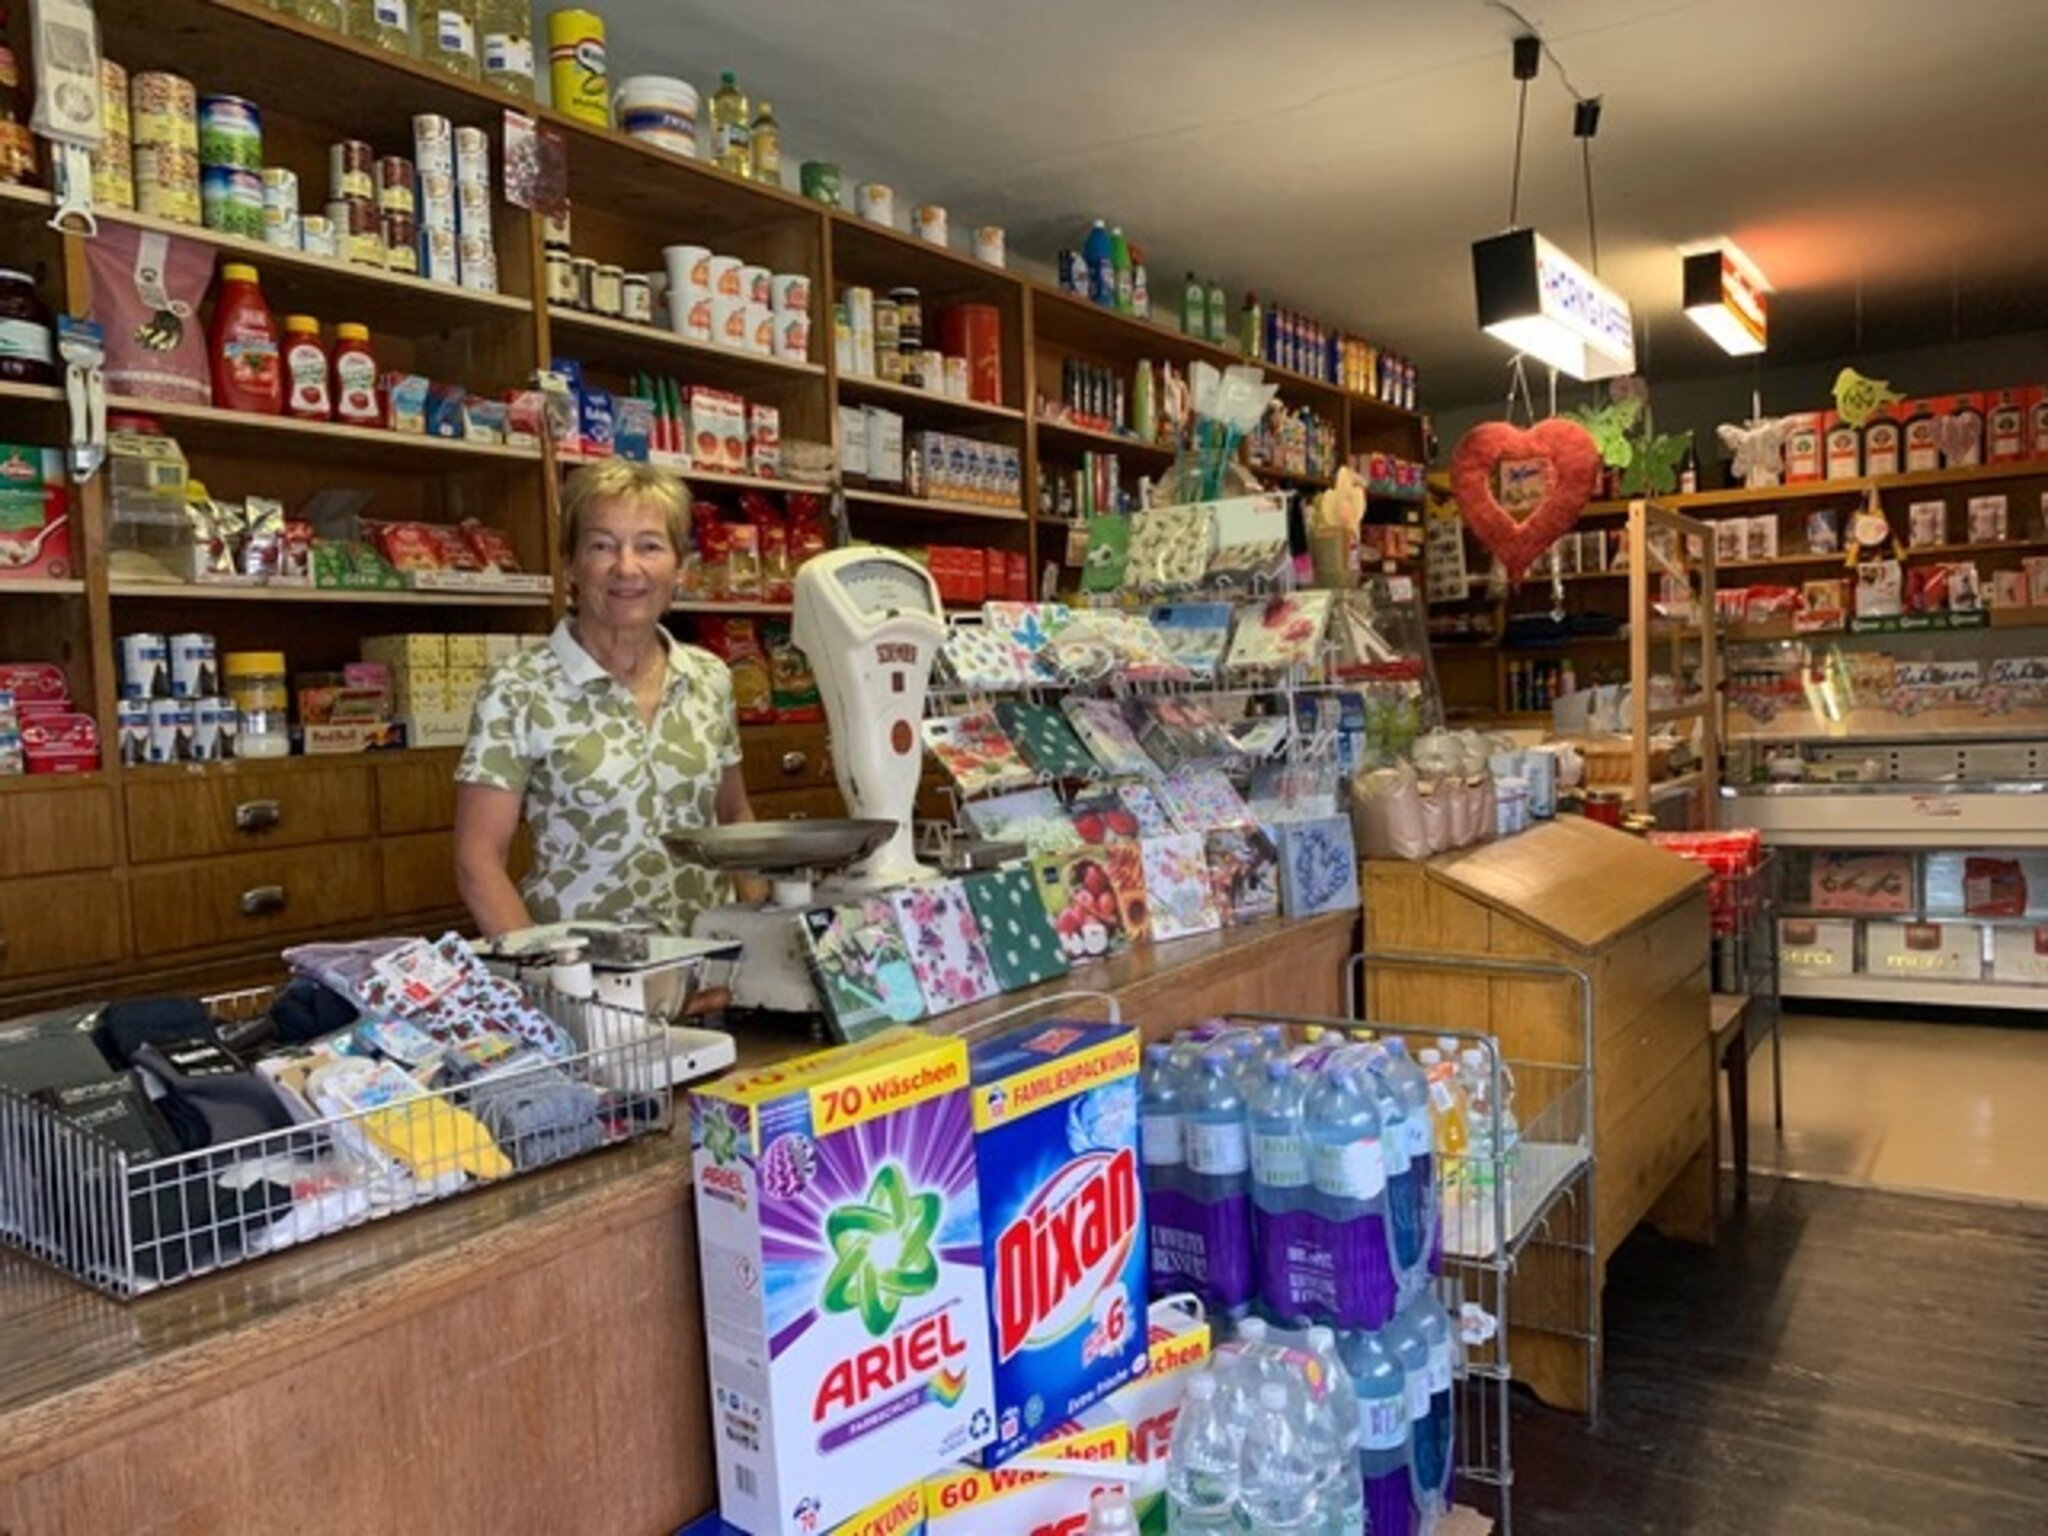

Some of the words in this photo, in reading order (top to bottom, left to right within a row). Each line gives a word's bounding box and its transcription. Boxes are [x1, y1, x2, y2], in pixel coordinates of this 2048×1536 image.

[819, 1085, 863, 1125] 70
[866, 1060, 958, 1105] Wäschen
[998, 1147, 1135, 1358] Dixan
[1106, 1295, 1125, 1342] 6
[812, 1311, 967, 1423] ARIEL
[940, 1476, 980, 1508] 60
